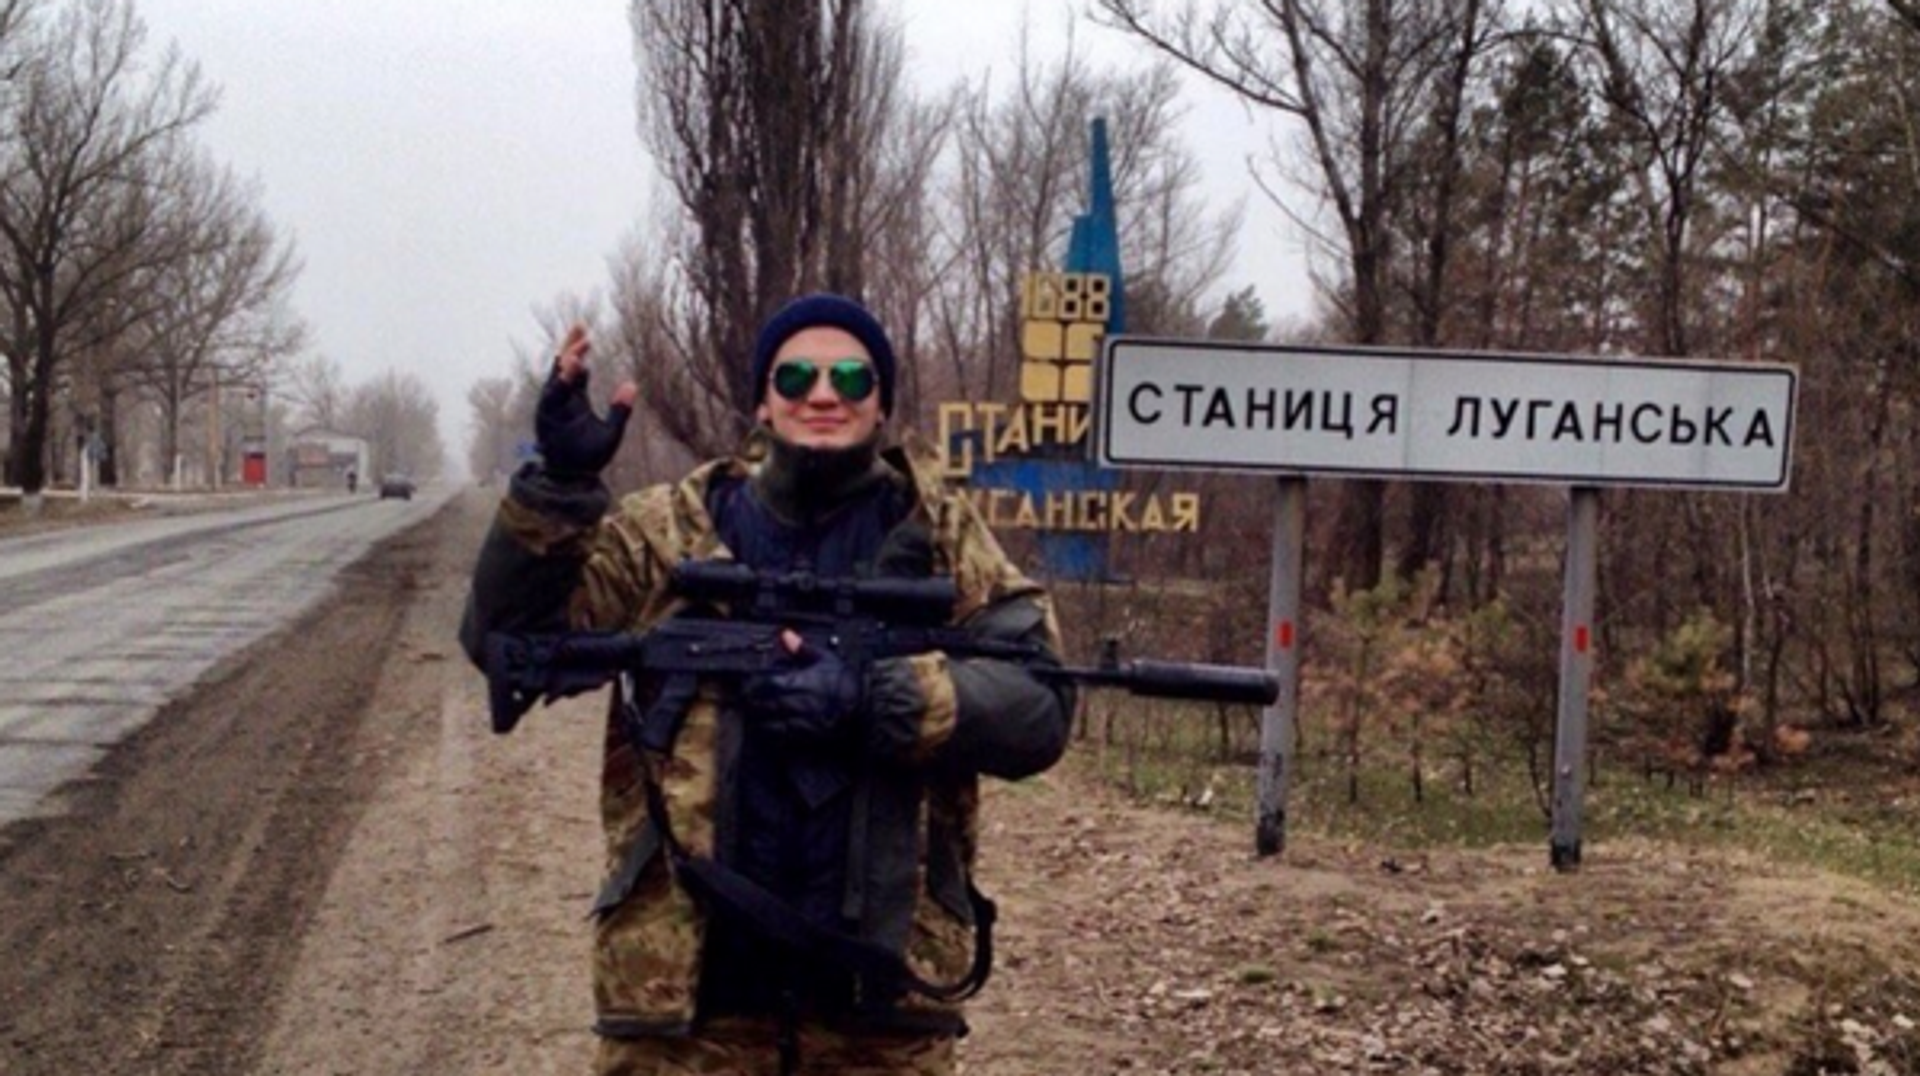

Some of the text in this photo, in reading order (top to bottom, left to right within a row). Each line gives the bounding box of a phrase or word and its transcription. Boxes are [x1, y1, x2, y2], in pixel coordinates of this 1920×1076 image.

[1022, 273, 1111, 321] 1688
[939, 402, 1091, 477] СТАНИ
[1127, 382, 1775, 449] СТАНИЦЯ ЛУГАНСЬКА
[968, 488, 1199, 535] ГАНСКАЯ
